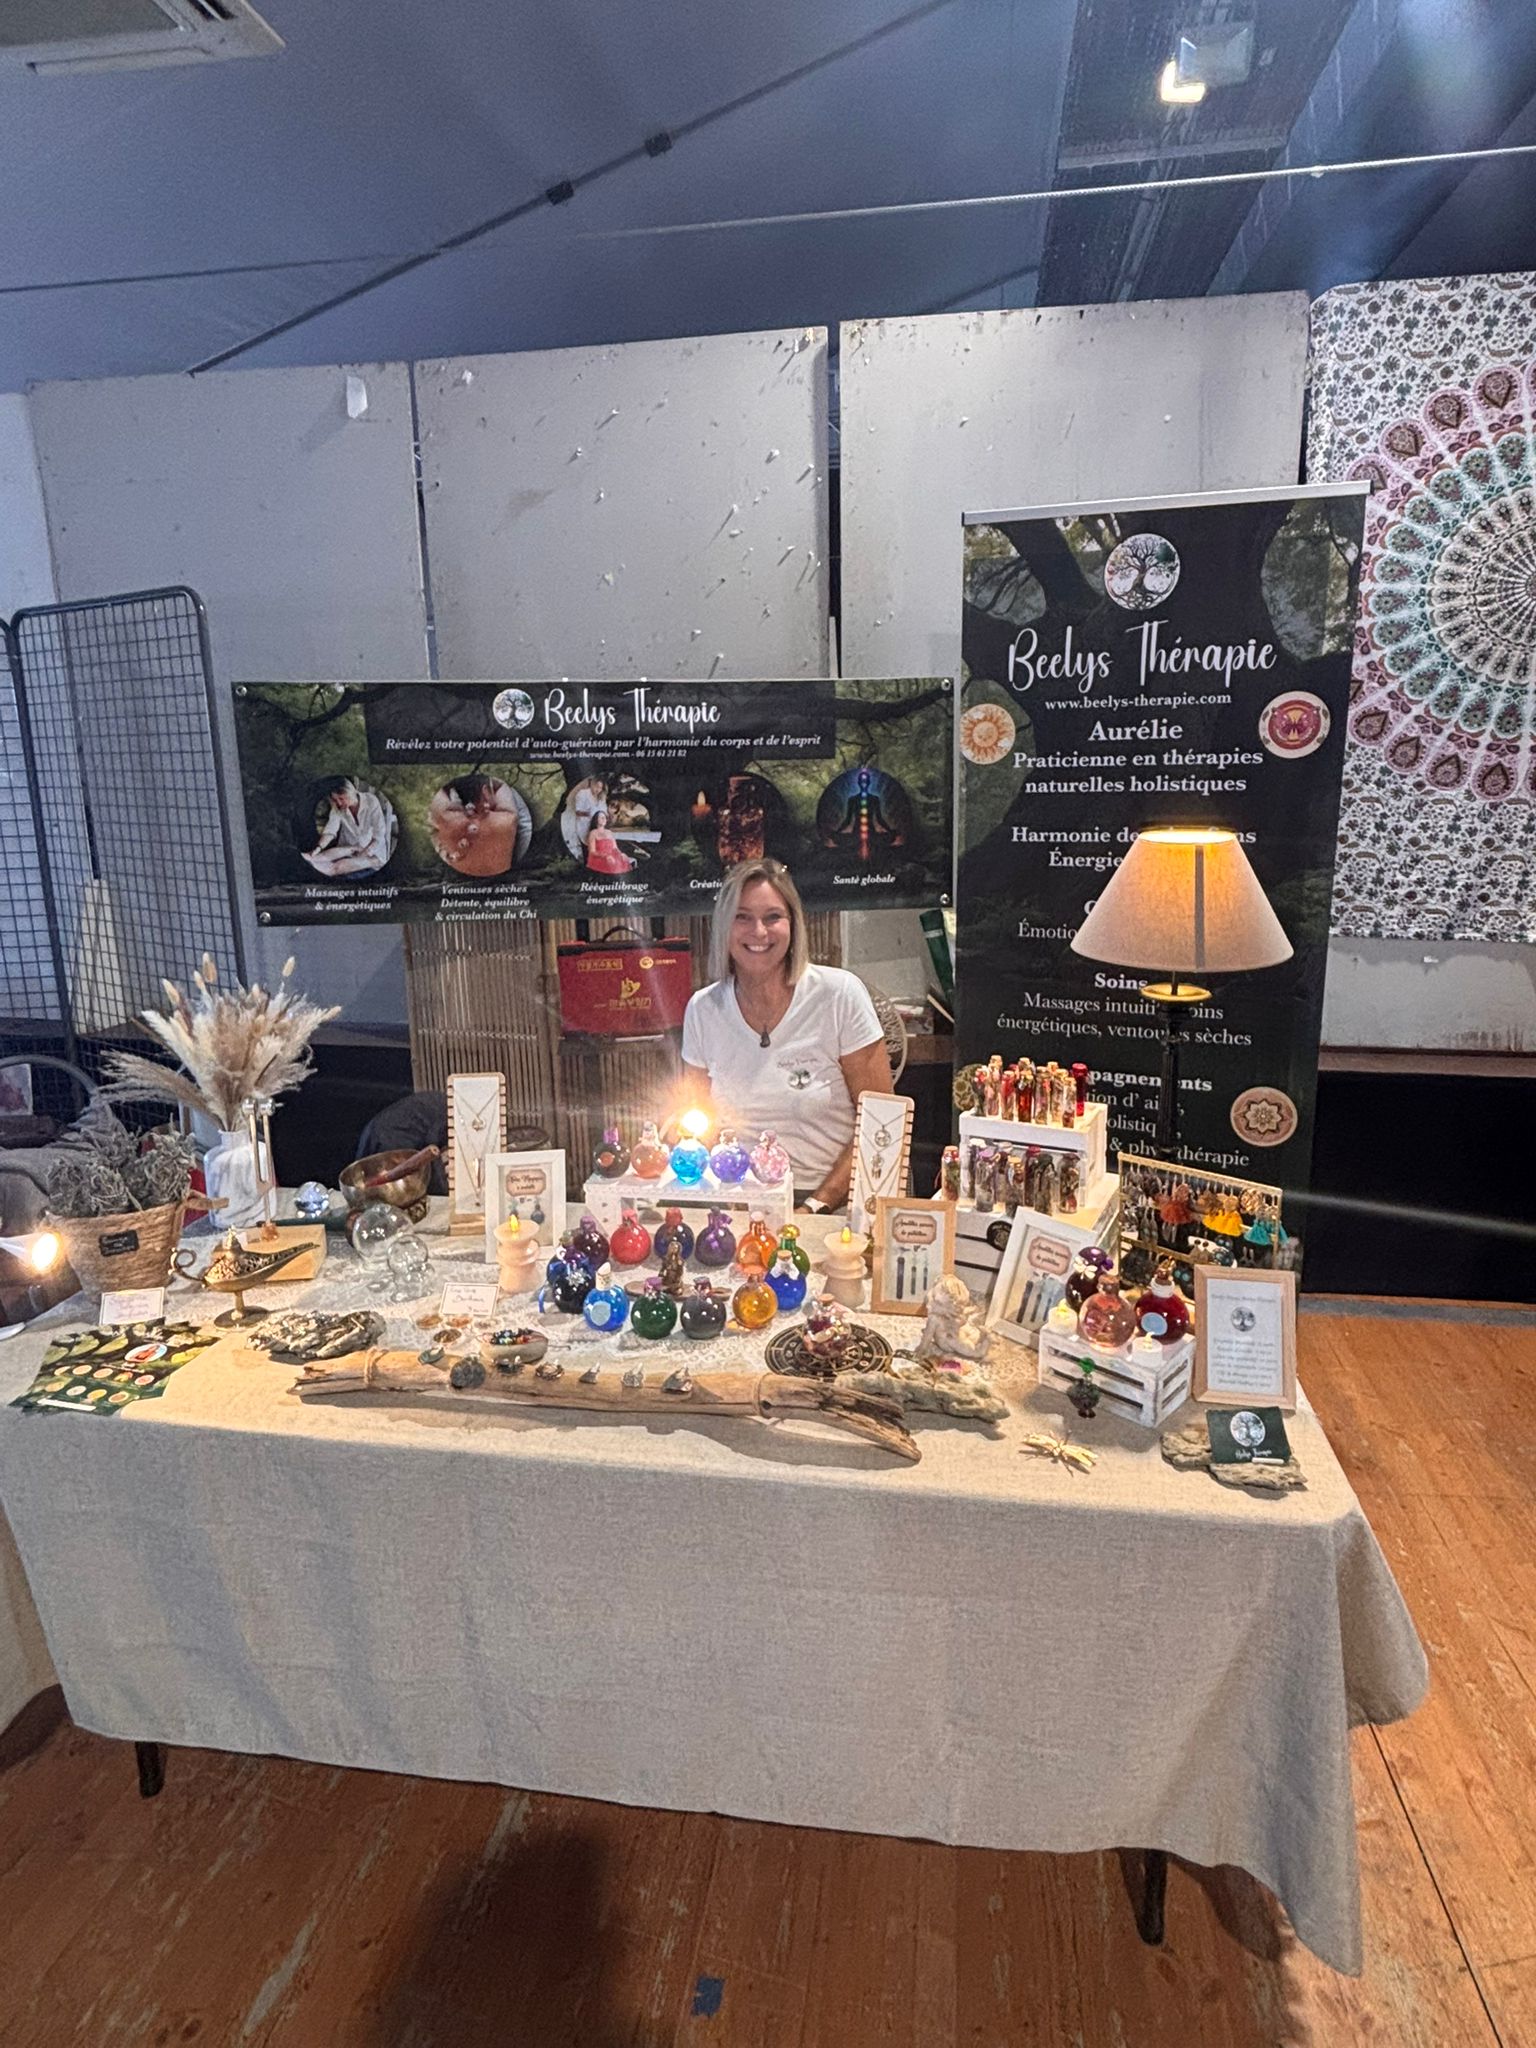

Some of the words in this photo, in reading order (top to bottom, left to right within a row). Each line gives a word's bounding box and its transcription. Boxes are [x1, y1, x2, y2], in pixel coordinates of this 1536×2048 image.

[1008, 625, 1113, 693] Beelys
[1125, 619, 1277, 688] Thérapie
[544, 688, 616, 735] Beelys
[622, 687, 721, 734] Thérapie
[1045, 692, 1232, 711] www.beelys-therapie.com
[1088, 718, 1184, 741] Aurélie
[434, 740, 466, 750] votre
[467, 737, 519, 752] potentiel
[613, 738, 635, 750] par
[637, 736, 700, 748] l'harmonie
[702, 735, 718, 747] du
[720, 737, 751, 749] corps
[753, 736, 764, 746] et
[766, 735, 780, 746] de
[782, 733, 821, 749] l'esprit
[1013, 751, 1127, 769] Praticienne
[1132, 754, 1157, 766] en
[1163, 748, 1264, 769] thérapies
[1025, 776, 1125, 793] naturelles
[1129, 775, 1247, 796] holistiques
[1011, 827, 1111, 843] Harmonie
[441, 884, 493, 895] Ventouses
[833, 873, 859, 884] Santé
[860, 874, 896, 887] globale
[304, 887, 354, 899] Massages
[357, 887, 399, 898] intuitifs
[314, 901, 324, 910] &
[434, 912, 443, 921] &
[446, 911, 501, 922] circulation
[503, 910, 517, 920] du
[519, 909, 538, 920] Chi
[1018, 917, 1078, 940] Émotio
[1023, 992, 1100, 1013] Massages
[997, 1013, 1102, 1038] énergétiques,
[1195, 1028, 1253, 1046] sèches
[1109, 1136, 1123, 1151] &
